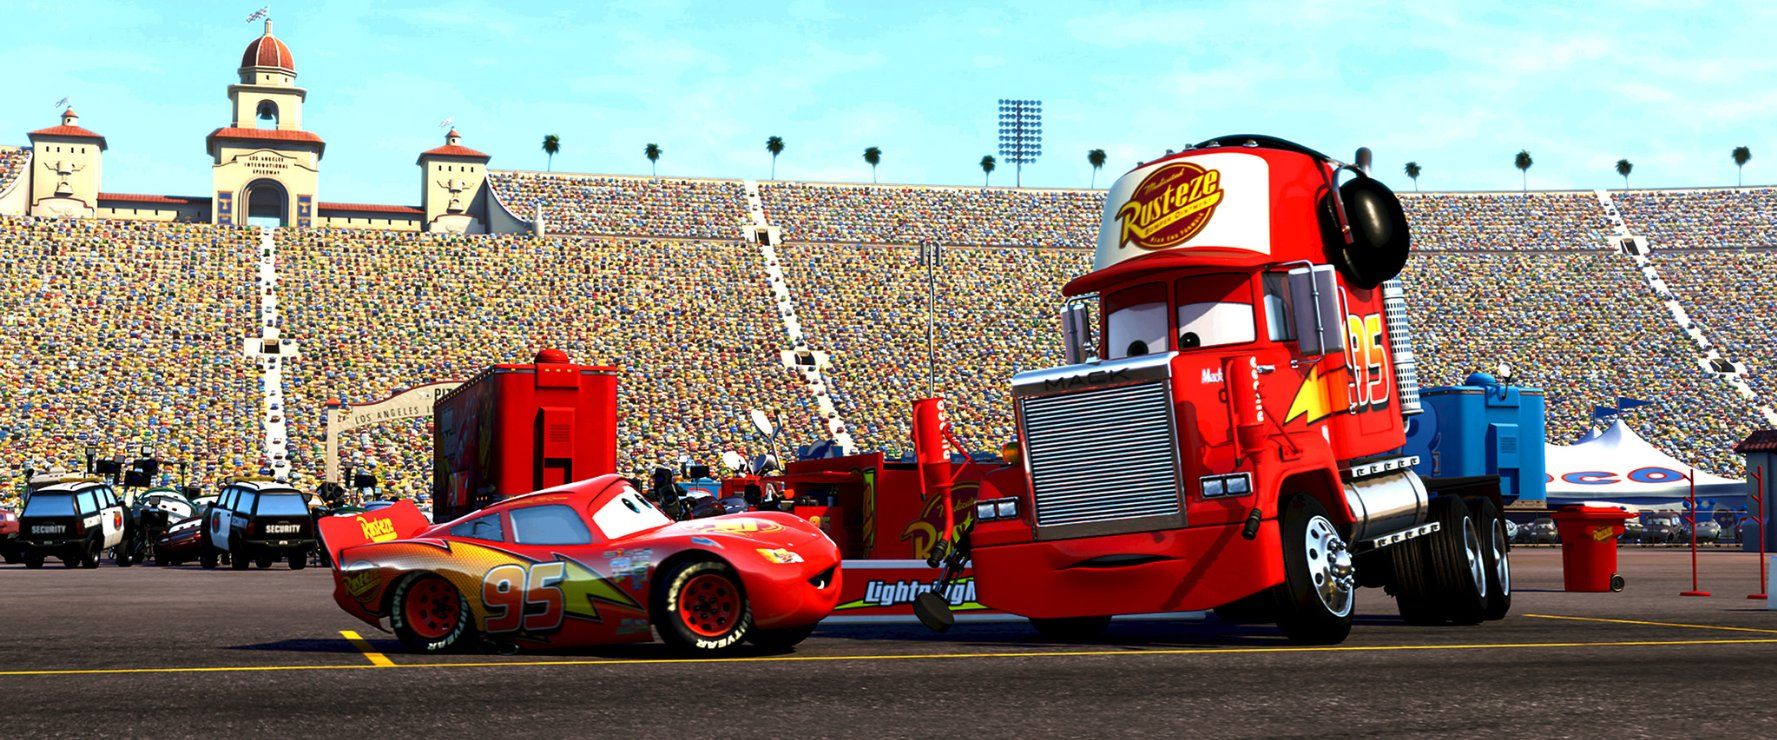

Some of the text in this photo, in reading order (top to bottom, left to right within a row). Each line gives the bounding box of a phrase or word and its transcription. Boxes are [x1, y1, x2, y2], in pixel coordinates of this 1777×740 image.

[1044, 367, 1129, 391] MACK
[355, 414, 372, 425] LOS
[377, 407, 419, 419] ANGELES
[31, 525, 66, 534] SECURITY
[265, 524, 301, 534] SECURITY
[482, 561, 566, 635] 95
